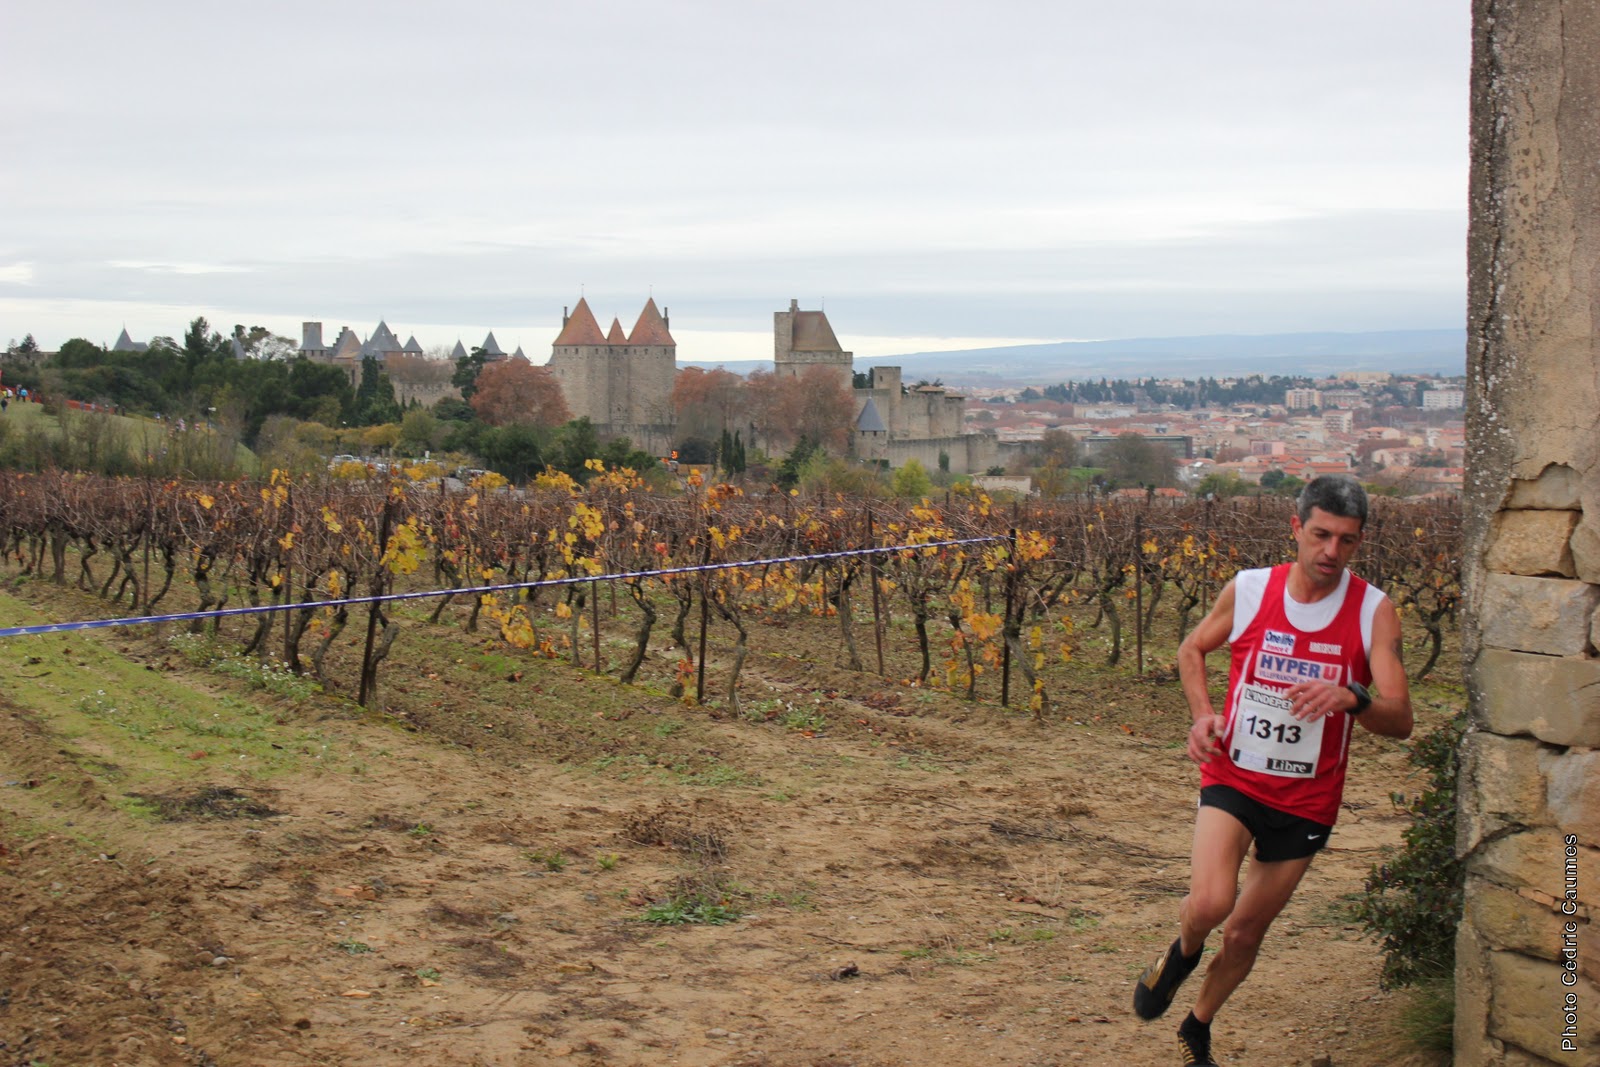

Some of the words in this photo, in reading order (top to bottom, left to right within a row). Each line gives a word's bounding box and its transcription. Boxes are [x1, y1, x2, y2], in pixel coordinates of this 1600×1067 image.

[1260, 654, 1321, 679] HYPER
[1322, 665, 1339, 680] U
[1246, 715, 1302, 744] 1313
[1271, 759, 1307, 773] Libre
